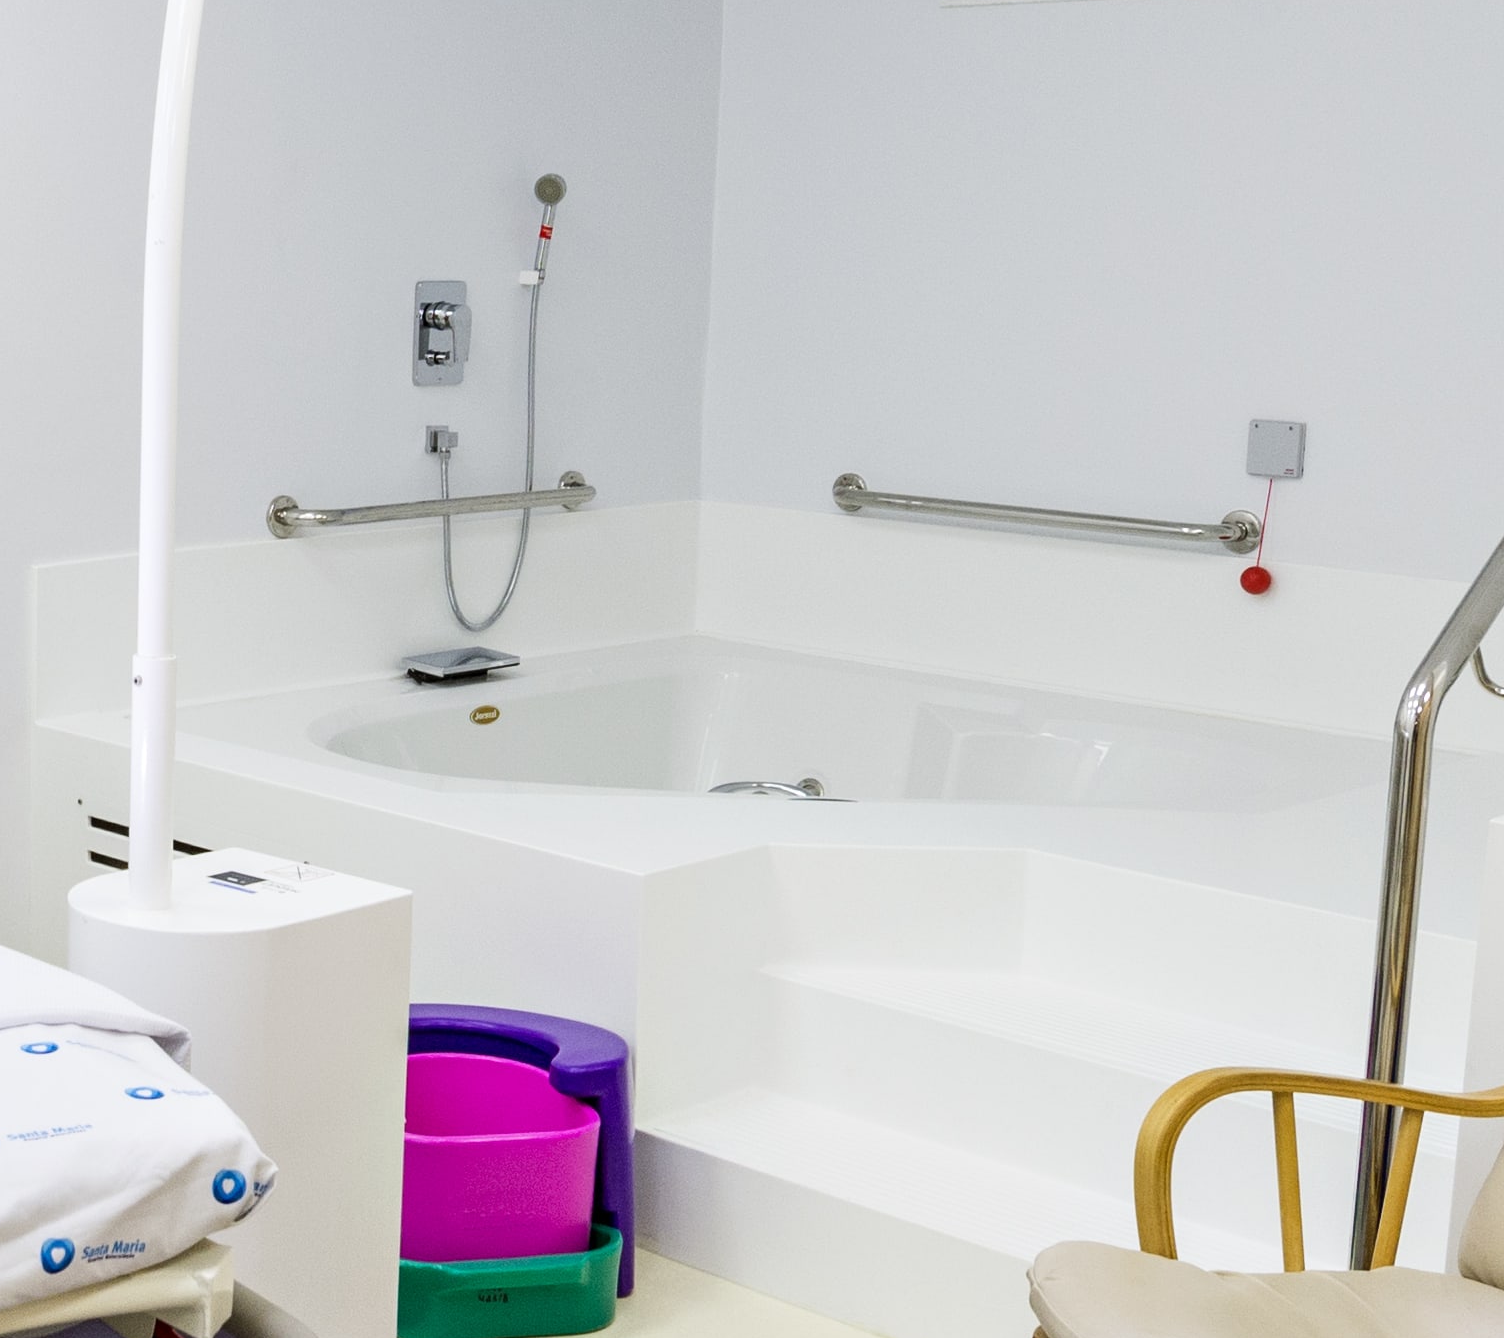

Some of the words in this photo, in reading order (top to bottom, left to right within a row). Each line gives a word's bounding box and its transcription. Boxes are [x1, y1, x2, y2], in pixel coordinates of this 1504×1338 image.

[6, 1128, 49, 1142] Santa
[51, 1122, 93, 1135] Maria
[81, 1244, 110, 1260] Santa
[110, 1238, 146, 1254] Maria
